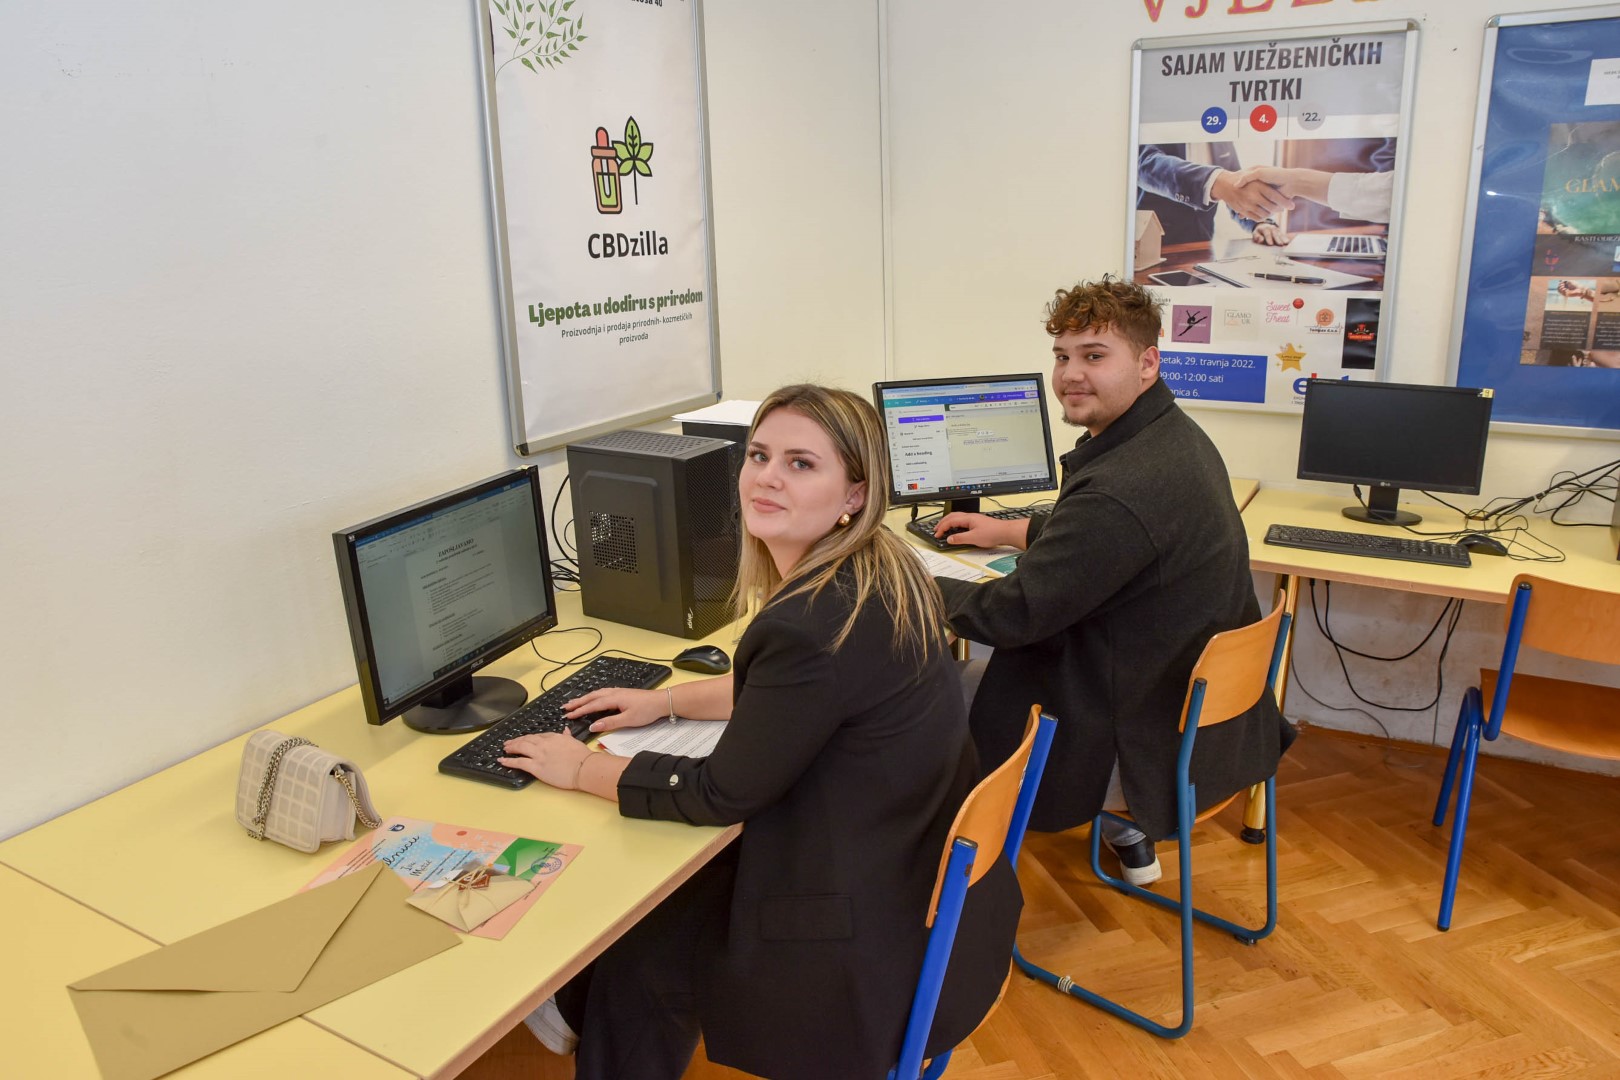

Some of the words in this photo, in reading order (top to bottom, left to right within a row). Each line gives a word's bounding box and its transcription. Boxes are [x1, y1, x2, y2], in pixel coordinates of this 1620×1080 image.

[1161, 51, 1226, 77] SAJAM
[1233, 38, 1383, 72] VJEŽBENIČKIH
[1229, 78, 1303, 103] TVRTKI
[1206, 115, 1222, 126] 29.
[1258, 113, 1269, 124] 4.
[587, 230, 669, 259] CBDzilla
[528, 302, 592, 327] Ljepota
[593, 303, 602, 316] u
[604, 294, 647, 315] dodiru
[648, 296, 656, 310] s
[656, 288, 703, 312] prirodom
[561, 325, 602, 338] Proizvodnja
[602, 324, 606, 332] i
[606, 322, 631, 334] prodaja
[619, 332, 649, 346] proizvoda
[1184, 357, 1198, 366] 29.
[1200, 358, 1230, 369] travnja
[1231, 359, 1256, 368] 2022.
[1208, 374, 1224, 382] sati
